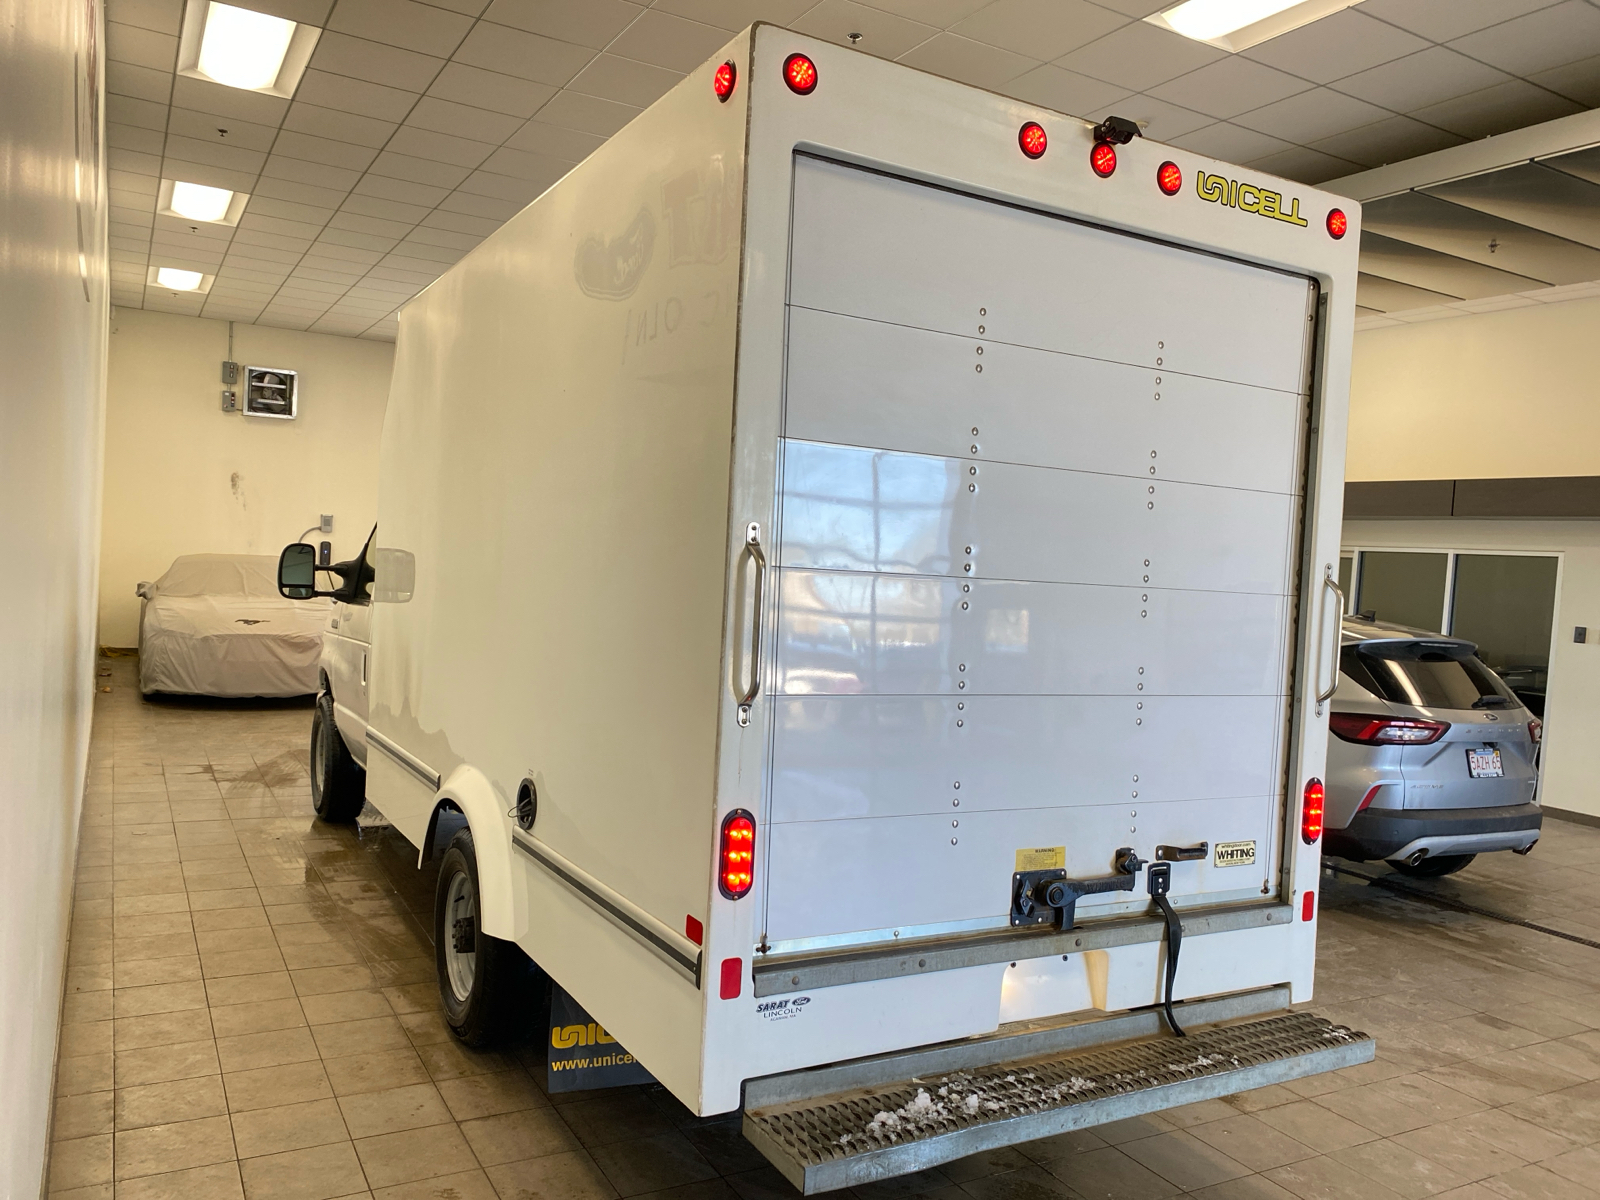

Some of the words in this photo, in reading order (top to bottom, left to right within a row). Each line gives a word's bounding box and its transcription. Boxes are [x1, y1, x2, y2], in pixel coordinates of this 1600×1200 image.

[1197, 171, 1308, 227] UNICELL
[1492, 756, 1501, 769] 65
[1216, 848, 1255, 860] WHITING
[756, 999, 790, 1012] SARAT
[764, 1007, 802, 1018] LINCOLN
